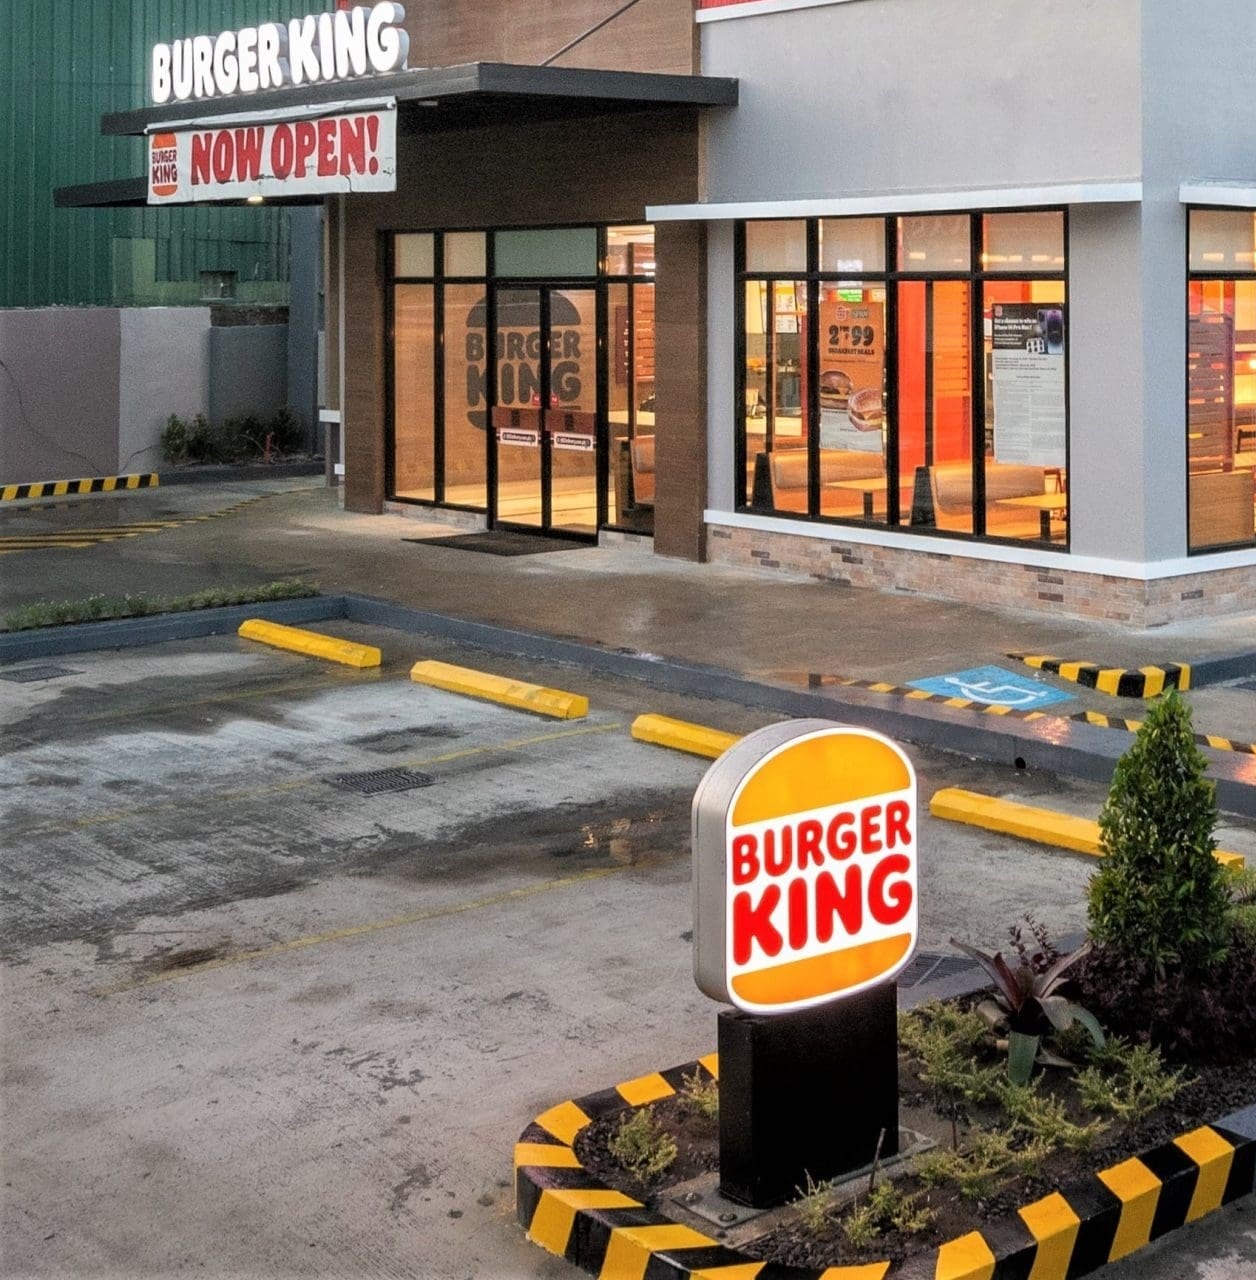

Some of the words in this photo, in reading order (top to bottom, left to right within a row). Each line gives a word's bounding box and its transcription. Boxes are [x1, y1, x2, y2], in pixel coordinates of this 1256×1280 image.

[152, 22, 284, 104] BURGER
[288, 1, 405, 85] KING
[152, 150, 177, 164] BURGER
[152, 164, 177, 184] KING
[191, 126, 265, 186] NOW
[270, 115, 380, 181] OPEN!
[828, 324, 839, 346] 2
[732, 800, 911, 886] BURGER
[732, 853, 913, 966] KING
